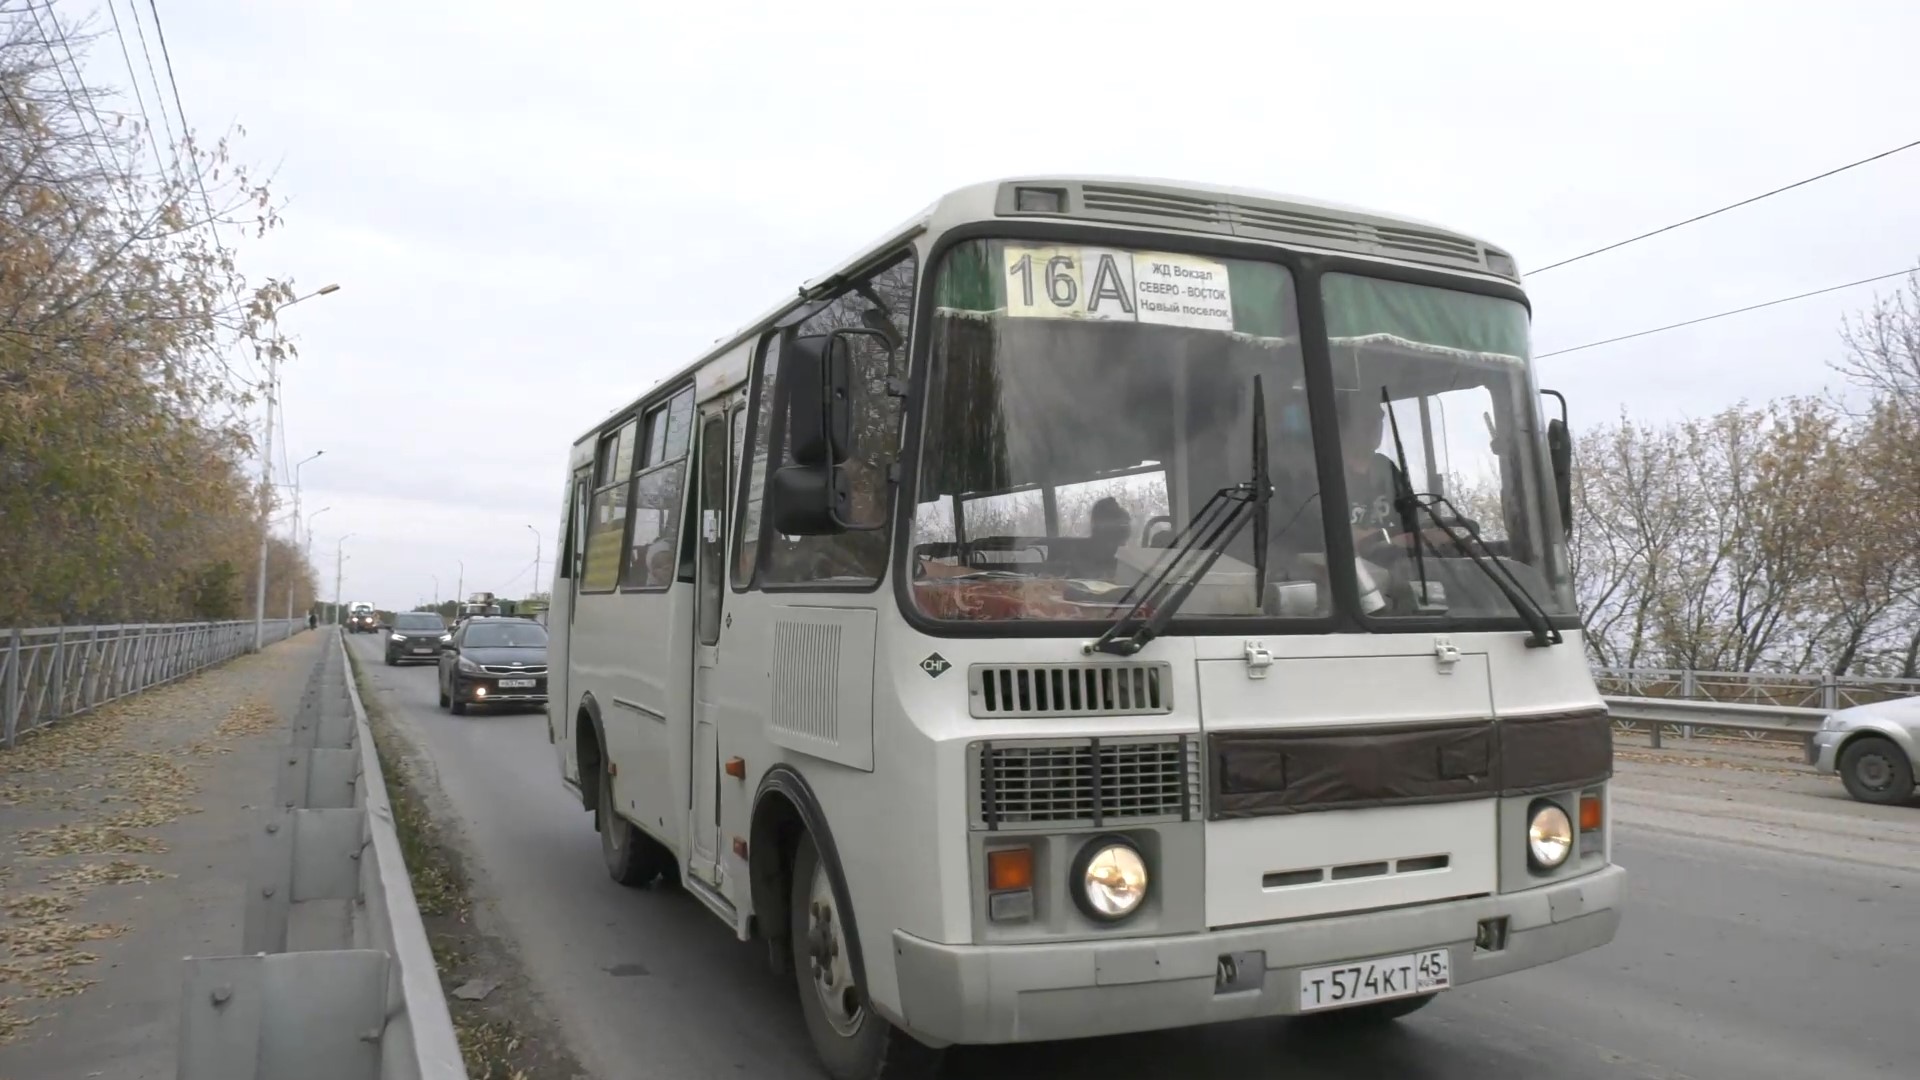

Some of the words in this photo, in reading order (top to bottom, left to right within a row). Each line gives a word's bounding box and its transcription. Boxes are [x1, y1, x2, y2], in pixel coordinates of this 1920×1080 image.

[1152, 262, 1172, 278] ЖД
[1174, 265, 1213, 281] Вокзал
[1139, 281, 1180, 296] СЕВЕРО
[1187, 287, 1227, 301] ВОСТОК
[1140, 299, 1181, 314] Новый
[1182, 304, 1229, 318] поселок
[1311, 965, 1411, 1003] Т574КТ
[1419, 953, 1442, 977] 45
